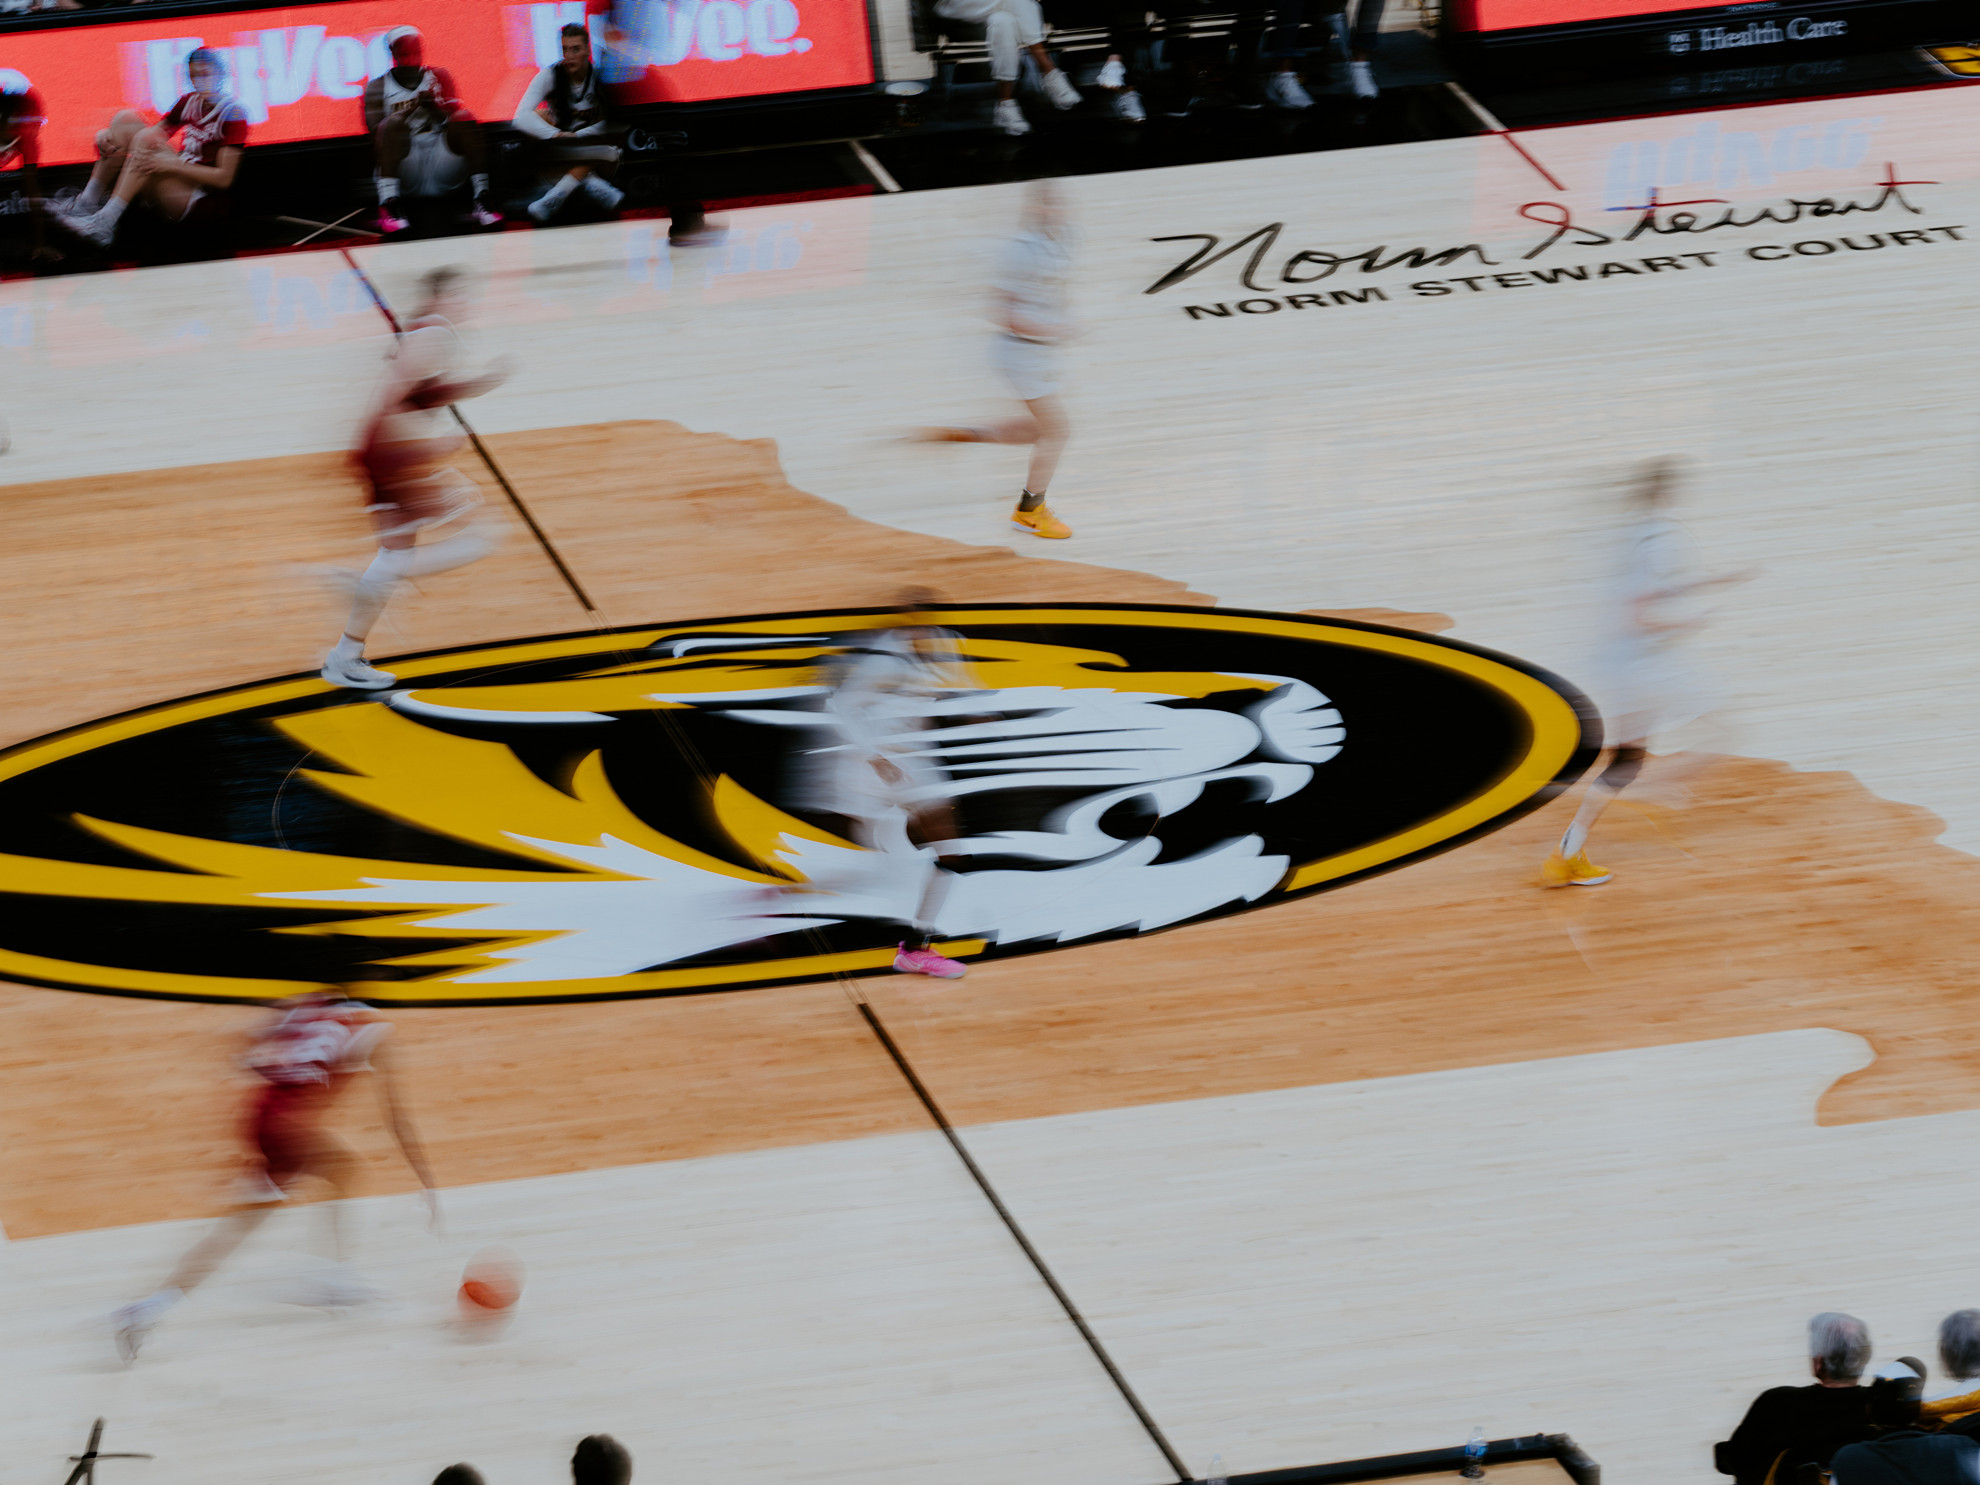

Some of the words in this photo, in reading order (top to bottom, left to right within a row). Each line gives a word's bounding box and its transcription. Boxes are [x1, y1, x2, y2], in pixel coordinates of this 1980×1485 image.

[1699, 20, 1785, 51] Health
[1786, 17, 1848, 40] Care
[1144, 222, 1501, 294] Norm
[1517, 161, 1940, 260] Stewart
[1184, 287, 1391, 320] NORM
[1409, 251, 1719, 297] STEWART
[1746, 225, 1968, 261] COURT
